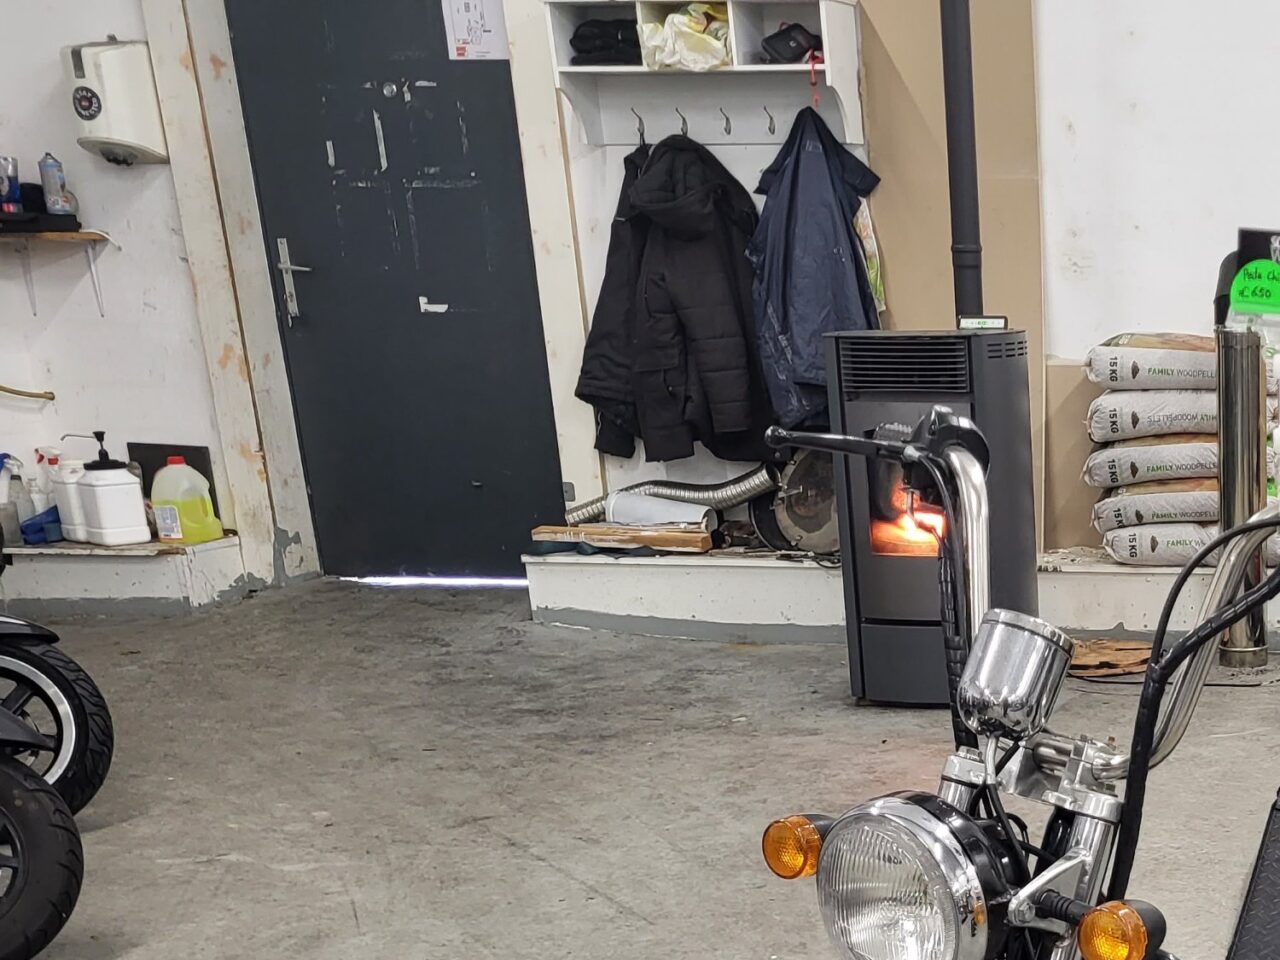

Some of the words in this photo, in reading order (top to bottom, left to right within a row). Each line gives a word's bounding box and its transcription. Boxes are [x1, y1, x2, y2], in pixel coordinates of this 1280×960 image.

[1109, 356, 1118, 368] 15
[1109, 368, 1118, 382] KG
[1147, 367, 1175, 376] FAMILY
[1176, 368, 1217, 379] WOODPELL
[1108, 408, 1118, 420] 15
[1109, 420, 1119, 434] KG
[1107, 459, 1116, 470] 15
[1146, 462, 1173, 473] FAMILY
[1109, 470, 1119, 484] KG
[1113, 508, 1123, 519] 15
[1151, 511, 1178, 519] FAMILY
[1179, 510, 1218, 518] WOODPELL
[1128, 532, 1137, 544] 15
[1166, 539, 1193, 548] FAMILY
[1128, 544, 1138, 558] KG
